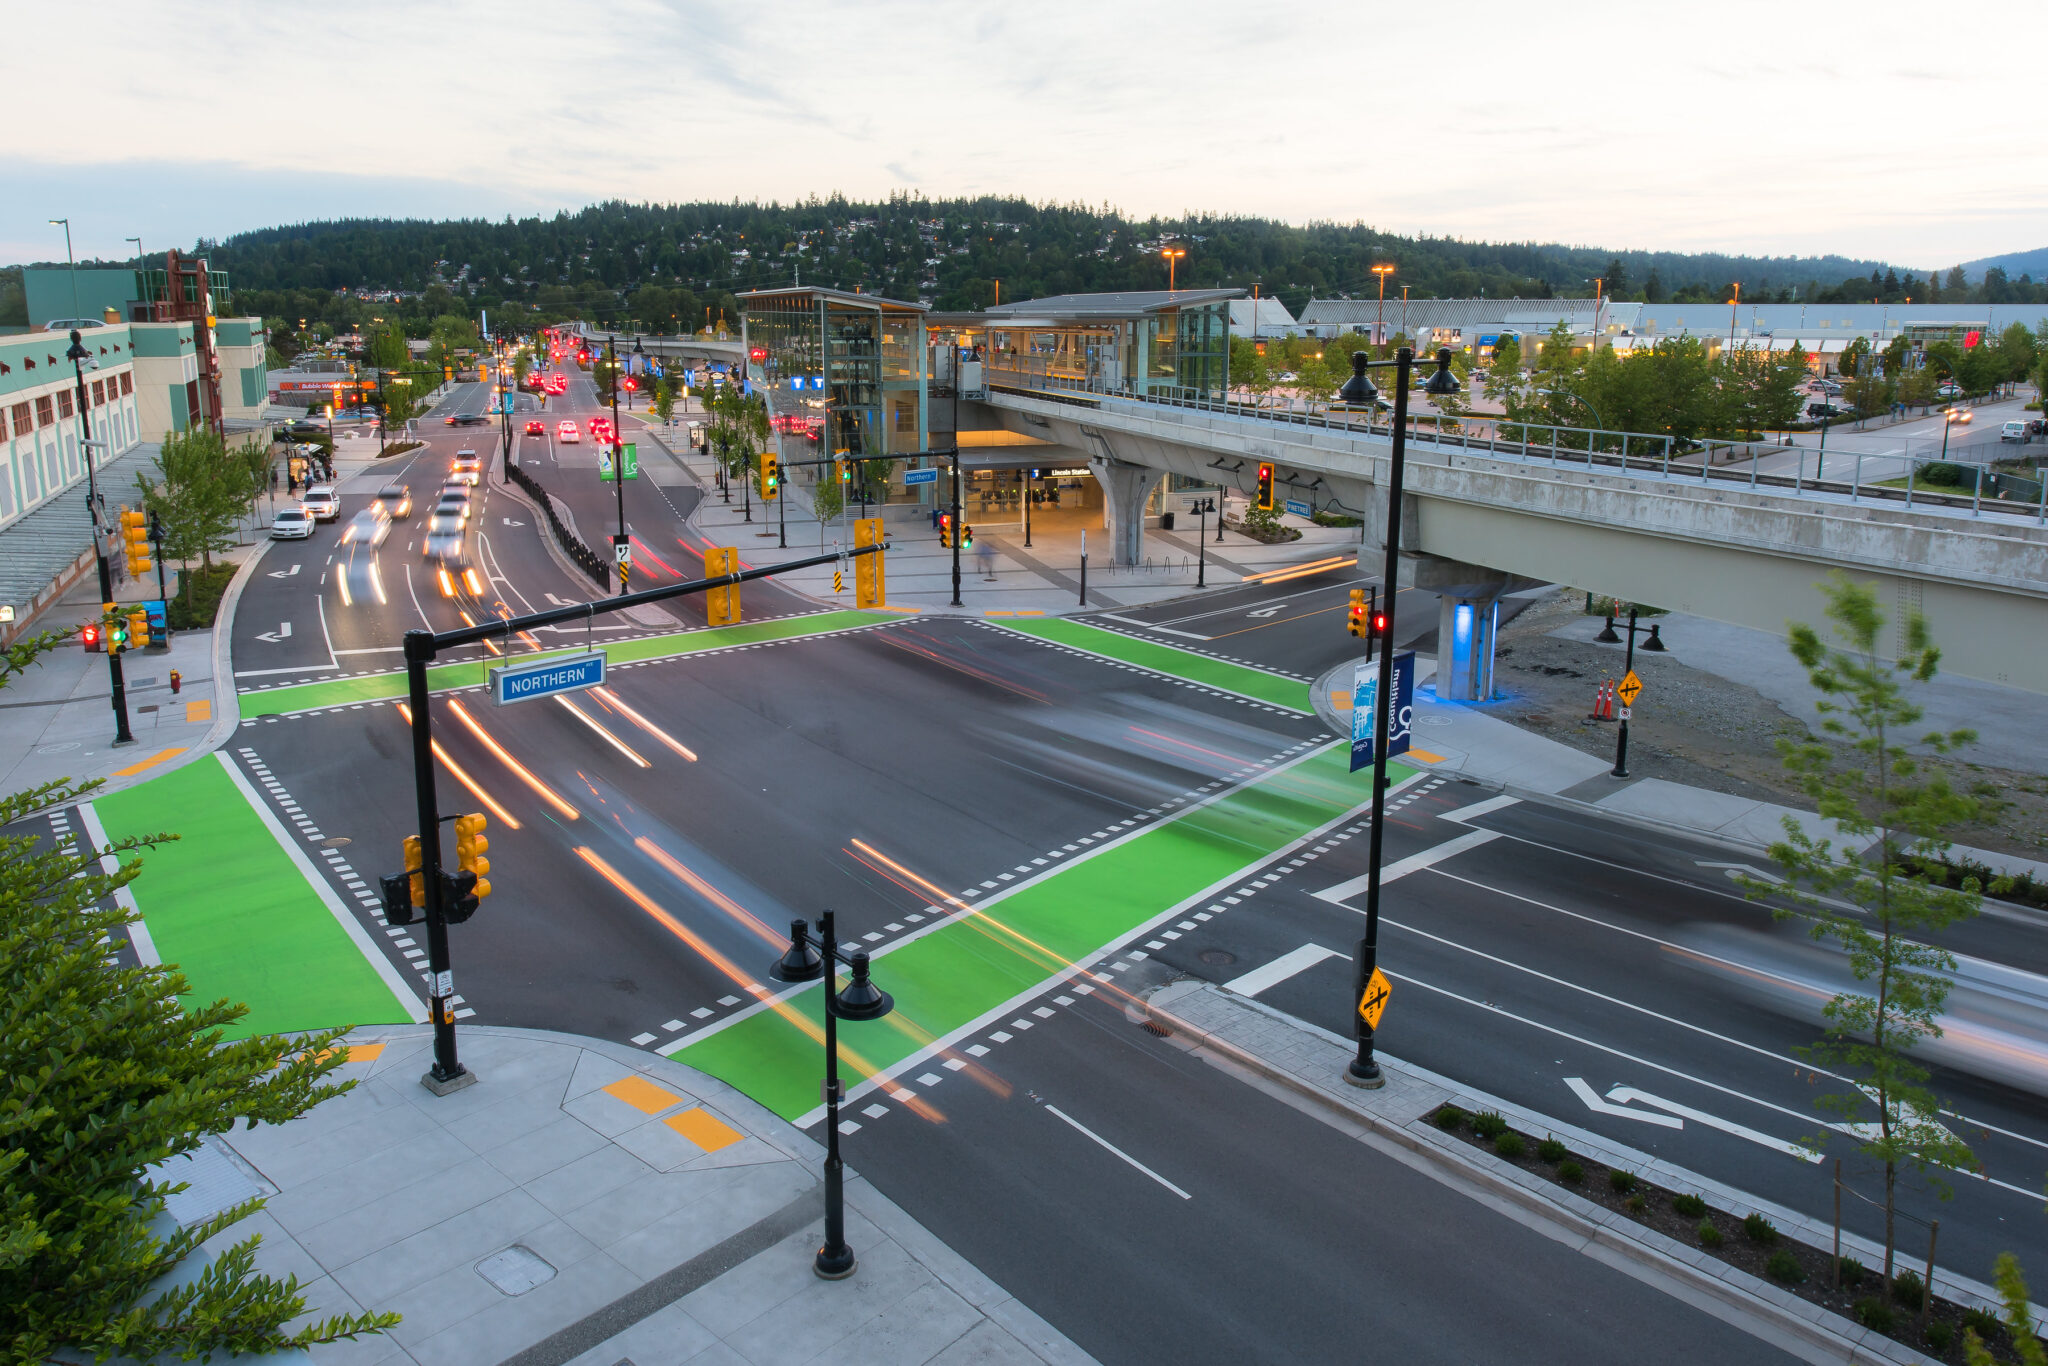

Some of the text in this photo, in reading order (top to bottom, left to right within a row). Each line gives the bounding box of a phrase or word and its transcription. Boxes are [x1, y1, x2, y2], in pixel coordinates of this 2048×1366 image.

[906, 473, 931, 482] Northern
[1287, 503, 1309, 515] PINETREE
[511, 667, 585, 694] NORTHERN
